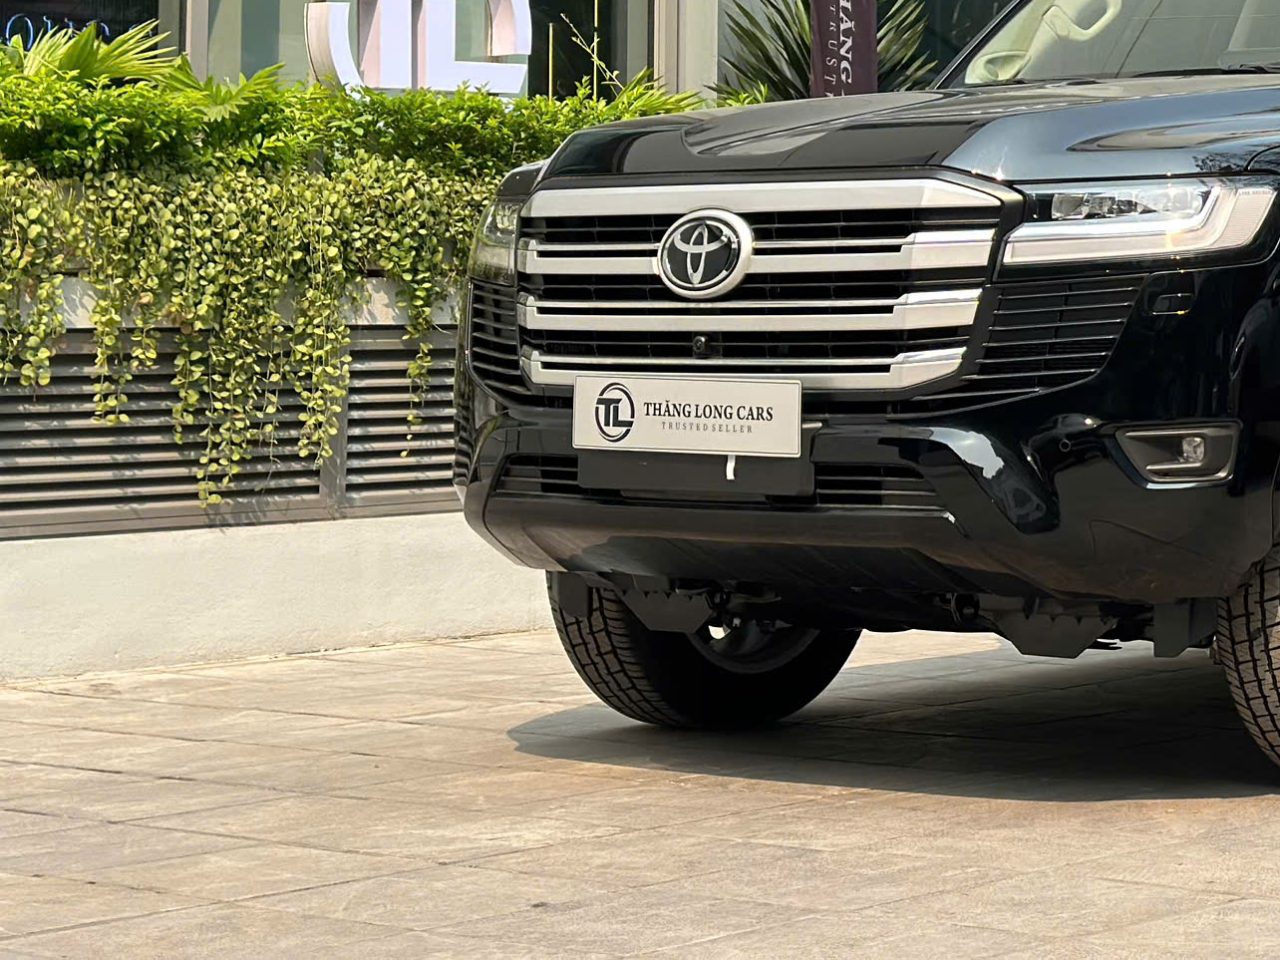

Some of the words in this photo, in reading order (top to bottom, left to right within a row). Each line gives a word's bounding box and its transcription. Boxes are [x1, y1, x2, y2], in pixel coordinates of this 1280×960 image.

[643, 400, 692, 418] THĂNG
[694, 404, 733, 420] LONG
[736, 406, 774, 422] CARS
[661, 421, 708, 432] TRUSTED
[711, 424, 753, 434] SELLER
